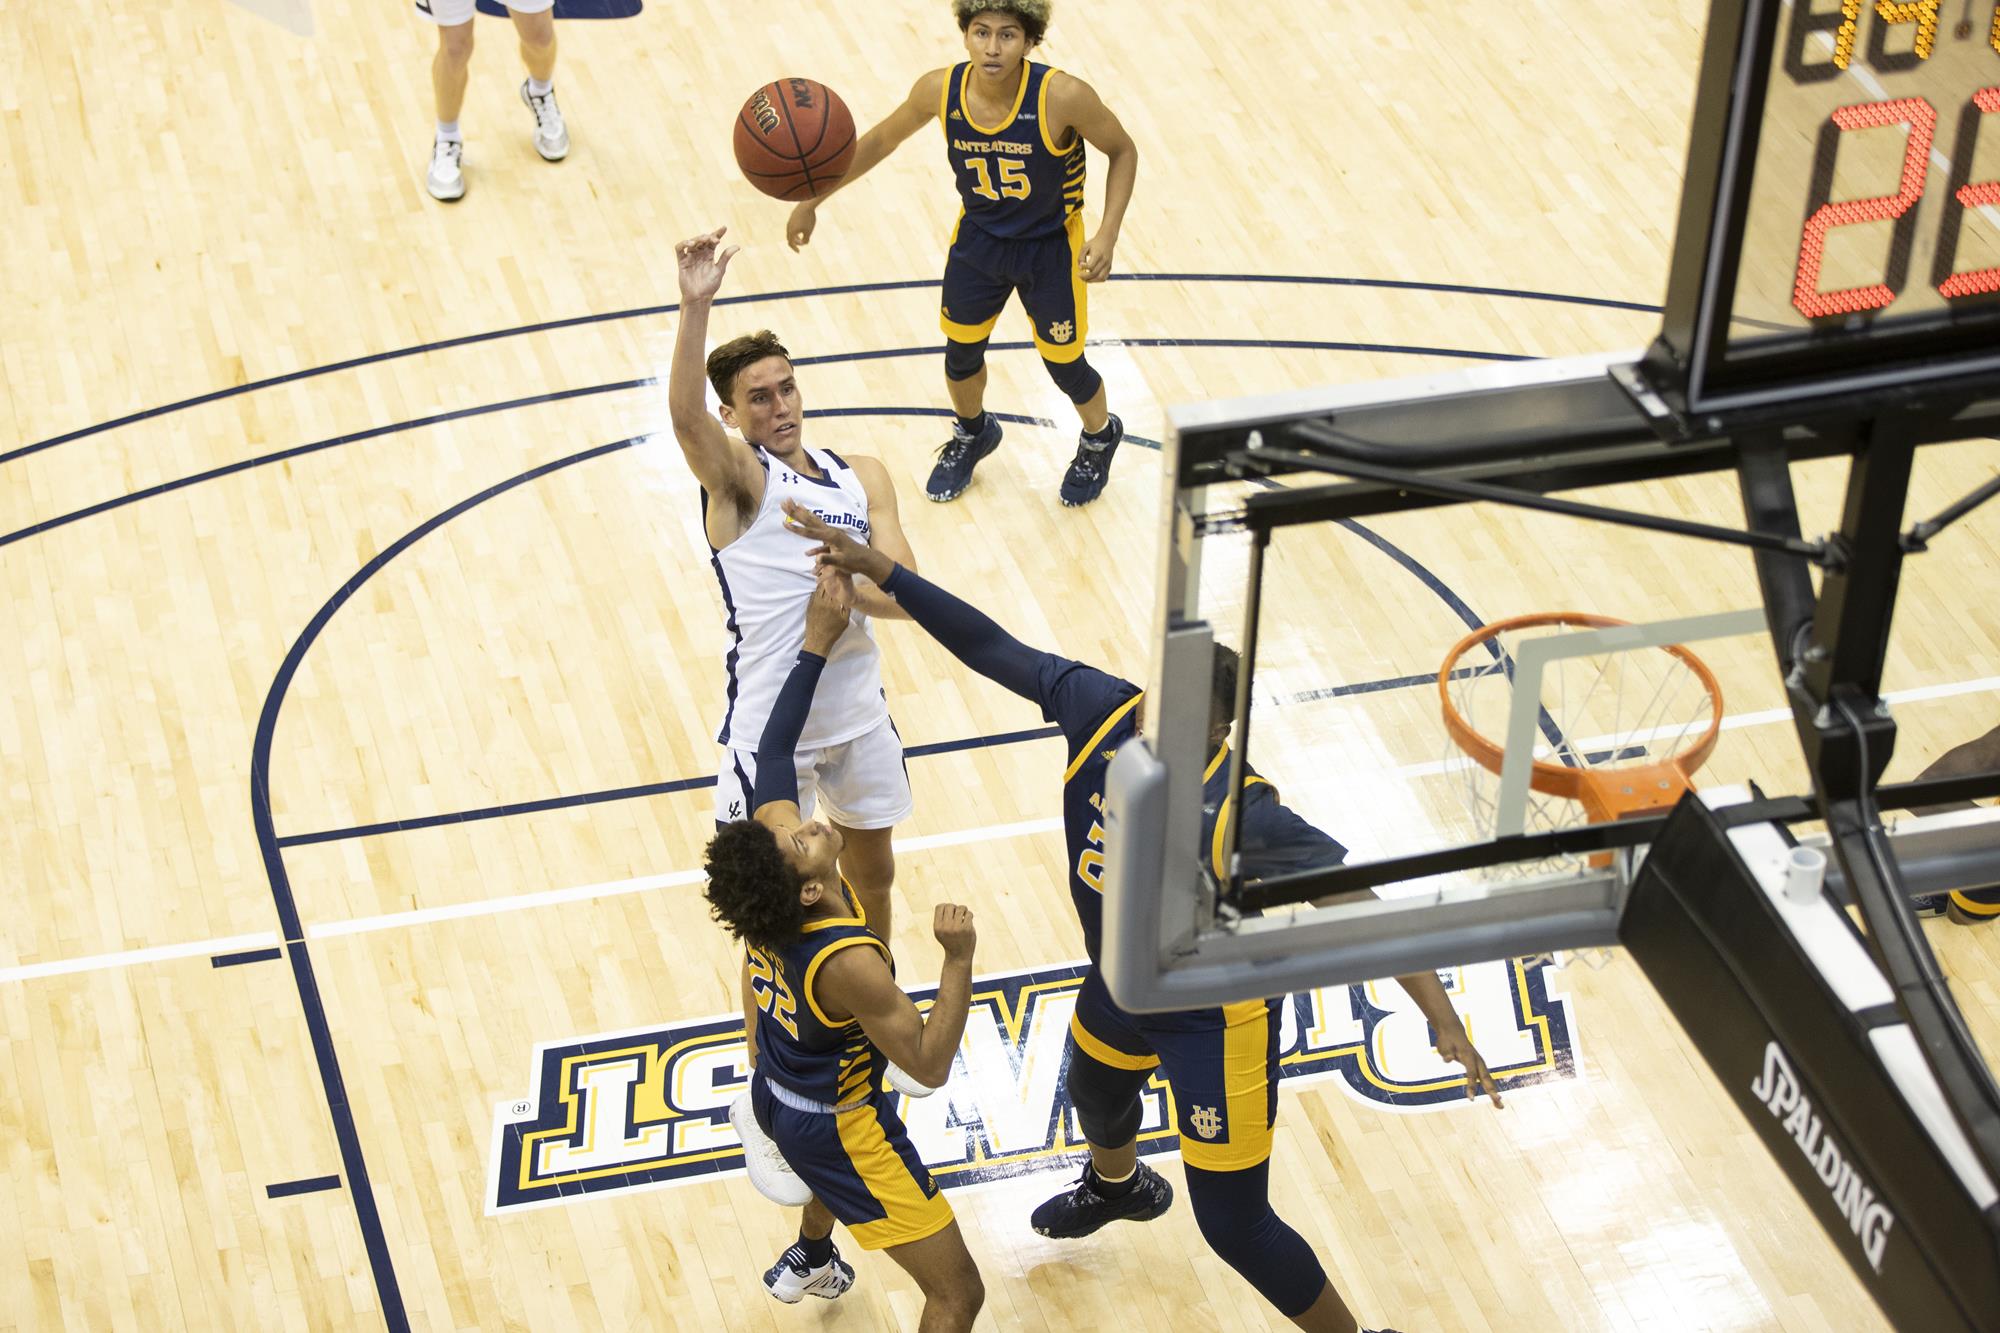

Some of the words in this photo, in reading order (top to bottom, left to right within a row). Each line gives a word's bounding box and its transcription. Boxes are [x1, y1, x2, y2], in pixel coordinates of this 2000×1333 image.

[953, 139, 1033, 155] ANTEATERS
[964, 157, 1032, 200] 15
[843, 512, 869, 534] Dieg
[746, 940, 799, 1041] 22
[1751, 1041, 1894, 1276] SPALDING
